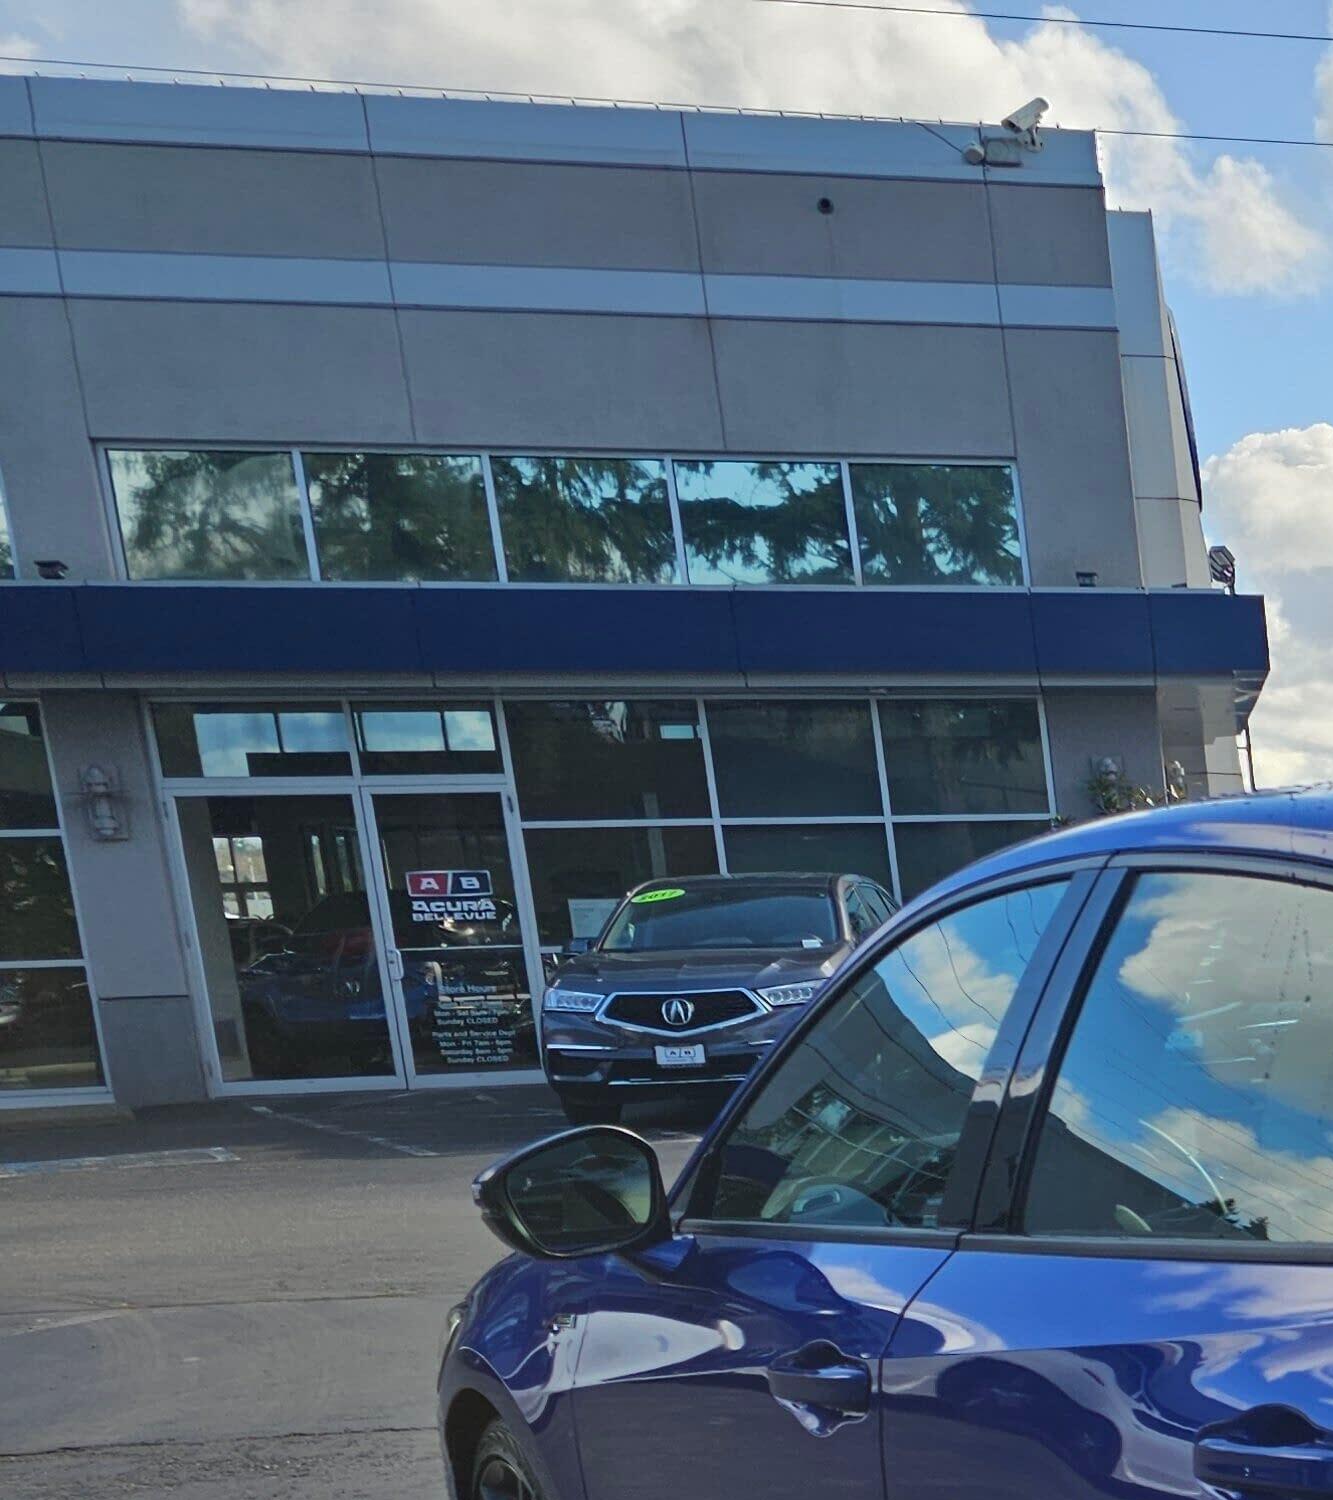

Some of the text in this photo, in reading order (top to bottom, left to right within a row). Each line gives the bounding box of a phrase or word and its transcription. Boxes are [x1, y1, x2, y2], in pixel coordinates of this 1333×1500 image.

[420, 876, 481, 890] A B
[411, 898, 497, 912] ACURA
[412, 911, 497, 922] BELLEVUE
